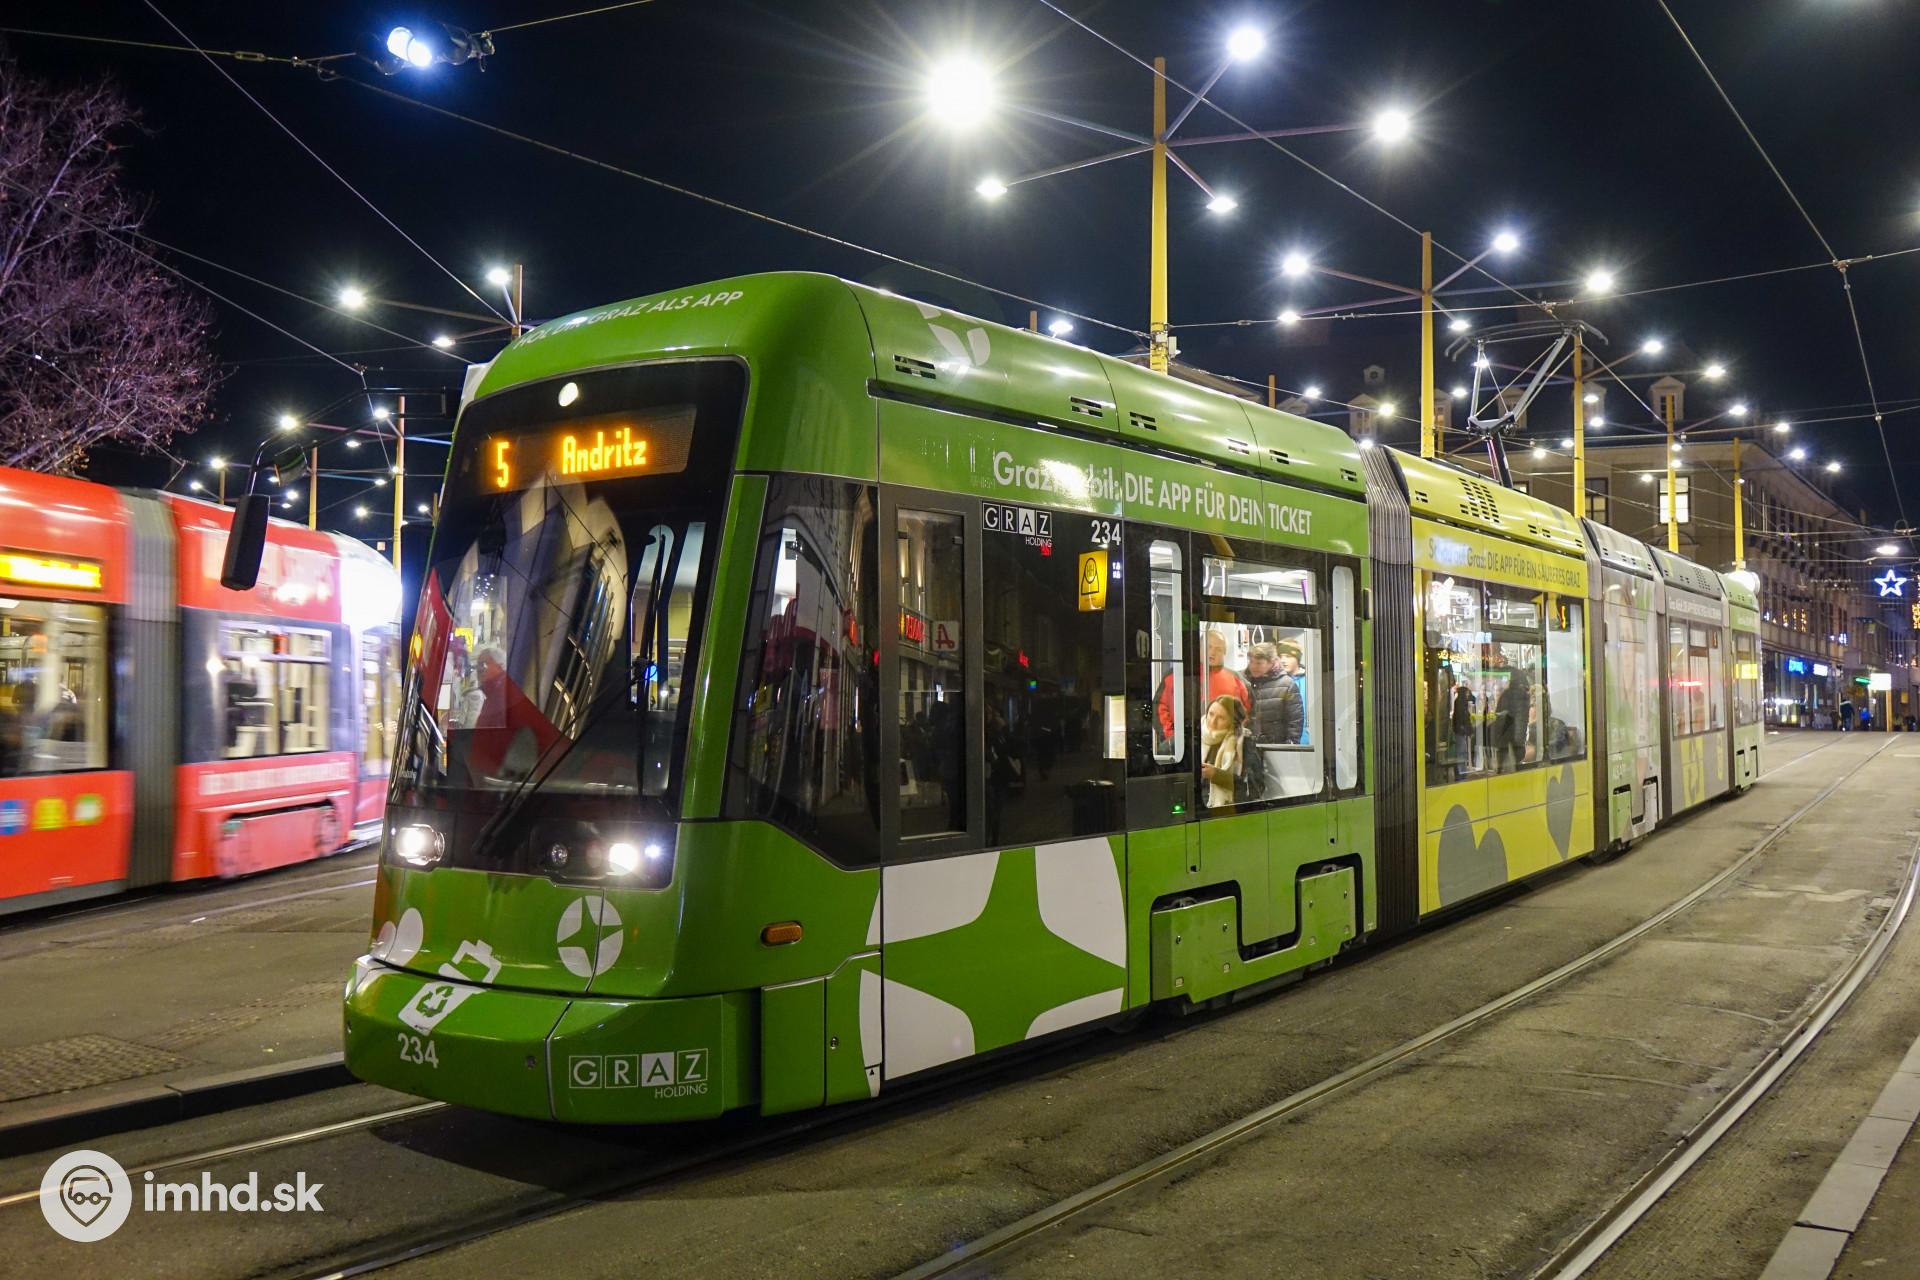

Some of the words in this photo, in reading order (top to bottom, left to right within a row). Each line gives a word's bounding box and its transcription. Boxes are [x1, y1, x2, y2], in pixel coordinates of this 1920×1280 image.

[586, 302, 650, 325] GRAZ
[646, 295, 693, 314] ALS
[691, 290, 744, 309] APP
[496, 441, 510, 488] 5
[562, 427, 647, 474] Andritz
[984, 506, 1050, 535] GRAZ
[1125, 471, 1154, 506] DIE
[1158, 480, 1192, 513] APP
[1195, 481, 1226, 520] FÜR
[1229, 494, 1264, 527] DEIN
[1267, 503, 1312, 536] TICKET
[1025, 536, 1053, 548] HOLDING
[1090, 519, 1122, 546] 234
[1487, 551, 1498, 572] DIE
[1500, 554, 1513, 573] APP
[1513, 553, 1526, 577] FÜR
[1526, 560, 1537, 579] EIN
[1565, 569, 1581, 588] GRAZ
[397, 1032, 440, 1069] 234
[572, 1053, 702, 1086] GRAZ
[655, 1083, 708, 1099] HOLDING
